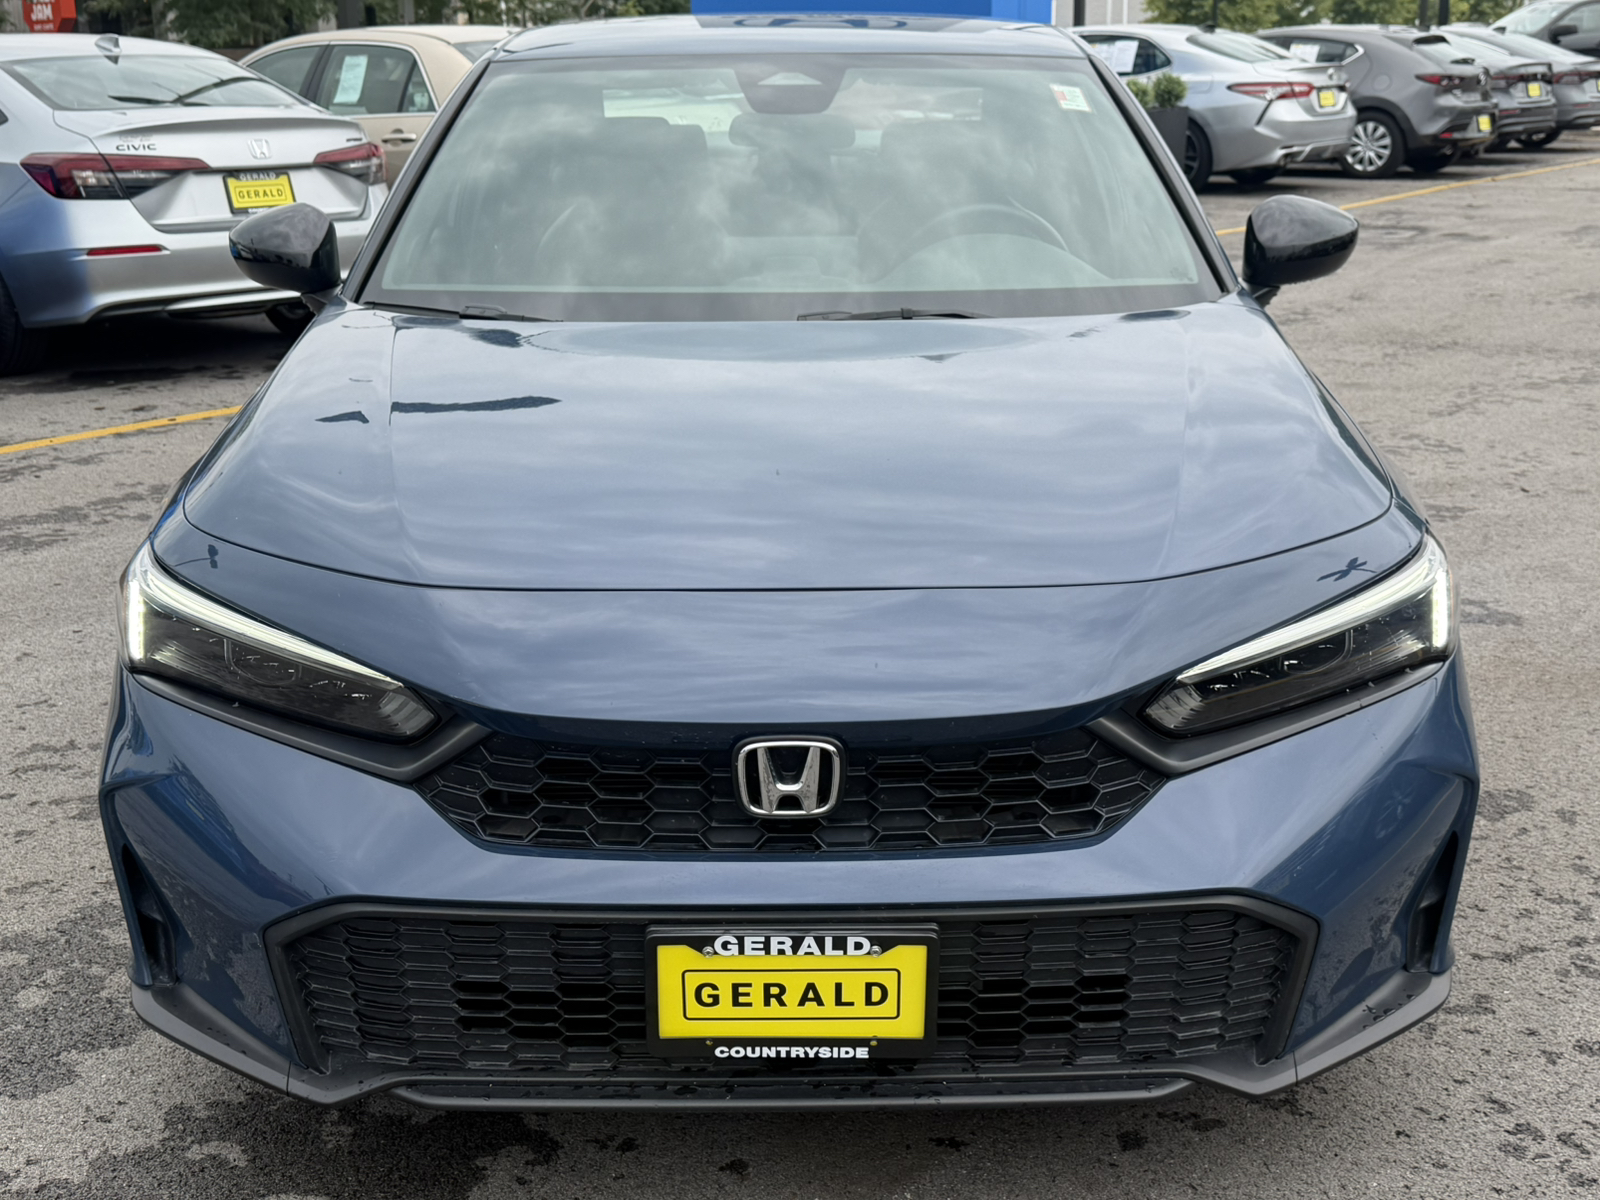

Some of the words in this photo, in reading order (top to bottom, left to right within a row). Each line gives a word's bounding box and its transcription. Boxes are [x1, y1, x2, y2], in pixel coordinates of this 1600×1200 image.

[115, 143, 157, 151] CIVIC
[239, 171, 276, 181] GERALD
[238, 188, 284, 200] GERALD
[713, 935, 871, 956] GERALD
[693, 981, 890, 1008] GERALD
[714, 1046, 870, 1059] COUNTRYSIDE
